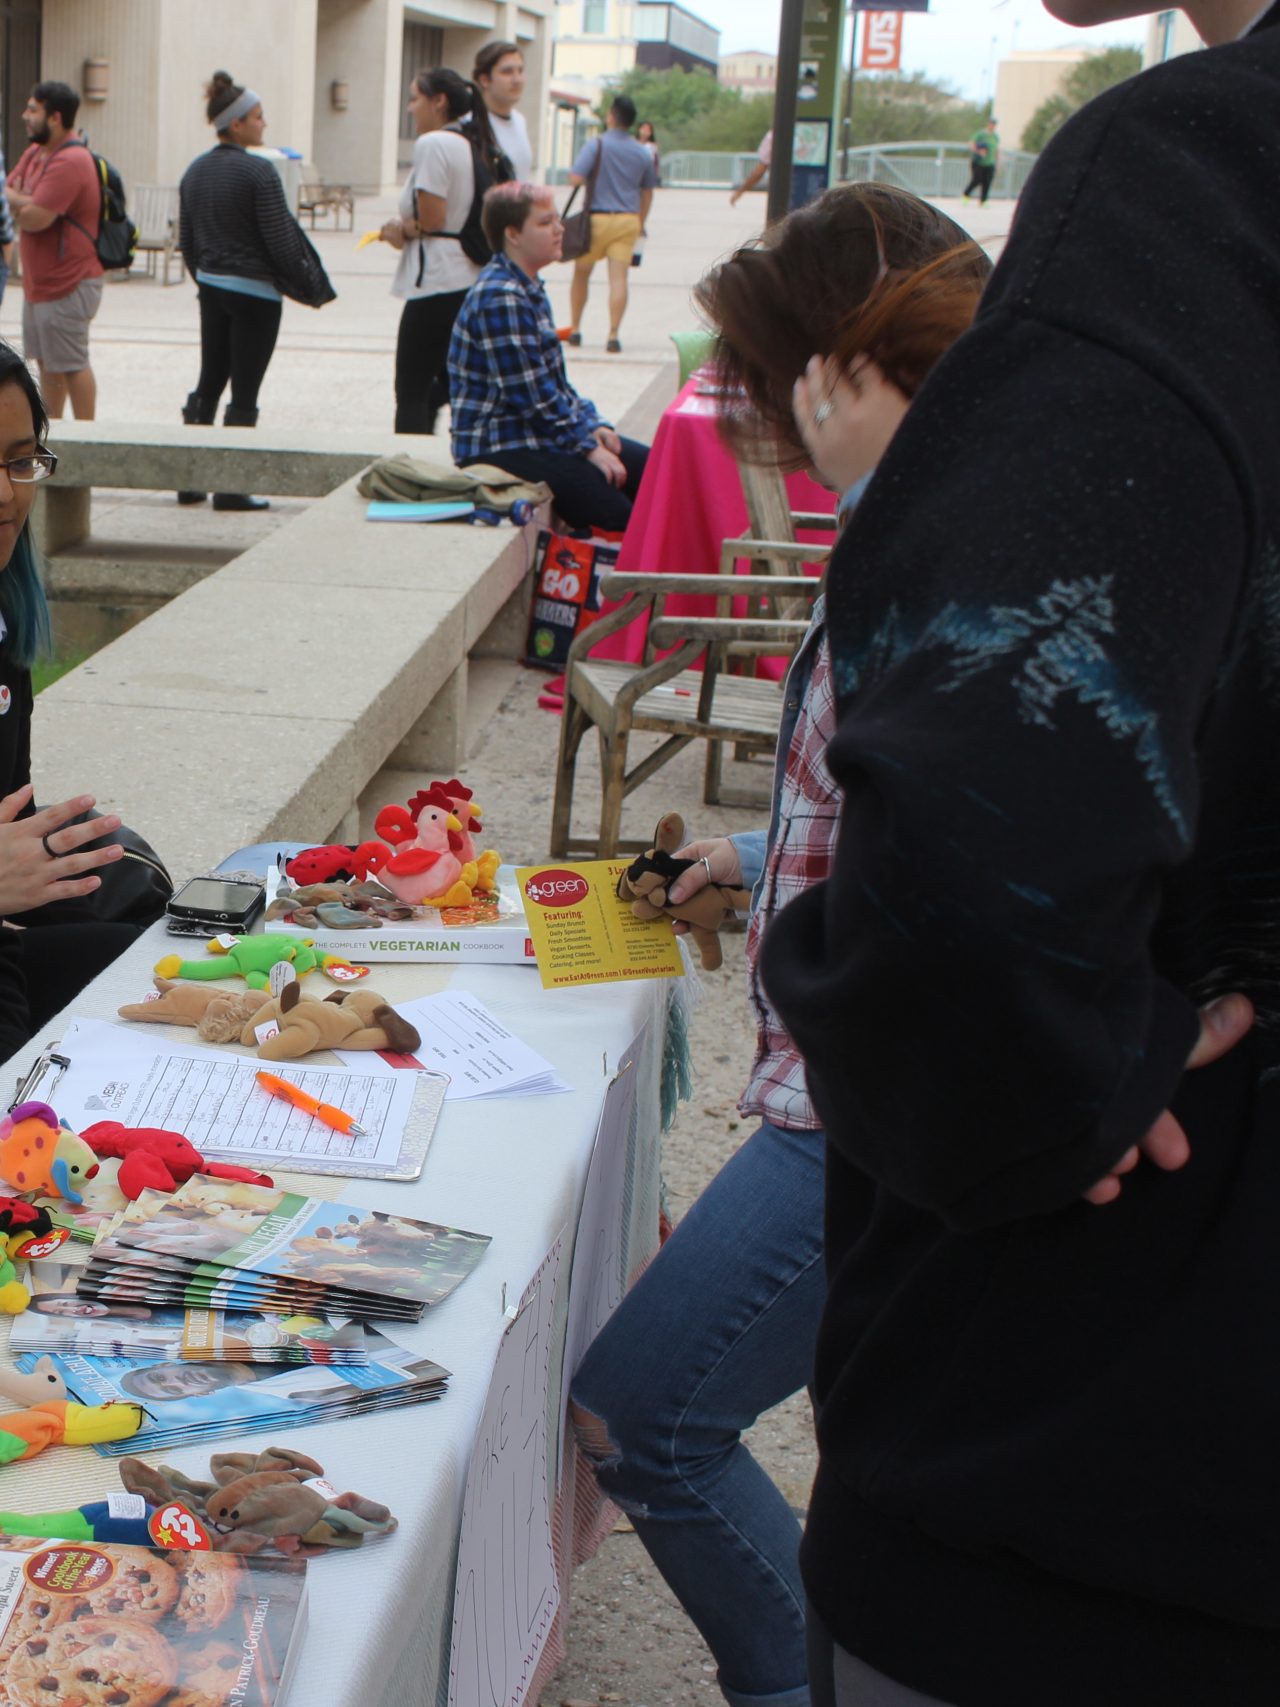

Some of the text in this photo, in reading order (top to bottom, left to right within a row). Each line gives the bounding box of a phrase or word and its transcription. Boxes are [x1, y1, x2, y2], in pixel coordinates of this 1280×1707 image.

[542, 568, 580, 599] GO
[541, 878, 588, 898] green
[544, 911, 583, 921] Featuring:
[314, 941, 328, 949] THE
[369, 940, 461, 952] VEGETARIAN
[161, 1507, 201, 1546] ty
[33, 1552, 60, 1578] Winner!
[47, 1551, 79, 1587] Cookbook
[72, 1553, 91, 1568] Year
[4, 1565, 21, 1596] Sweets
